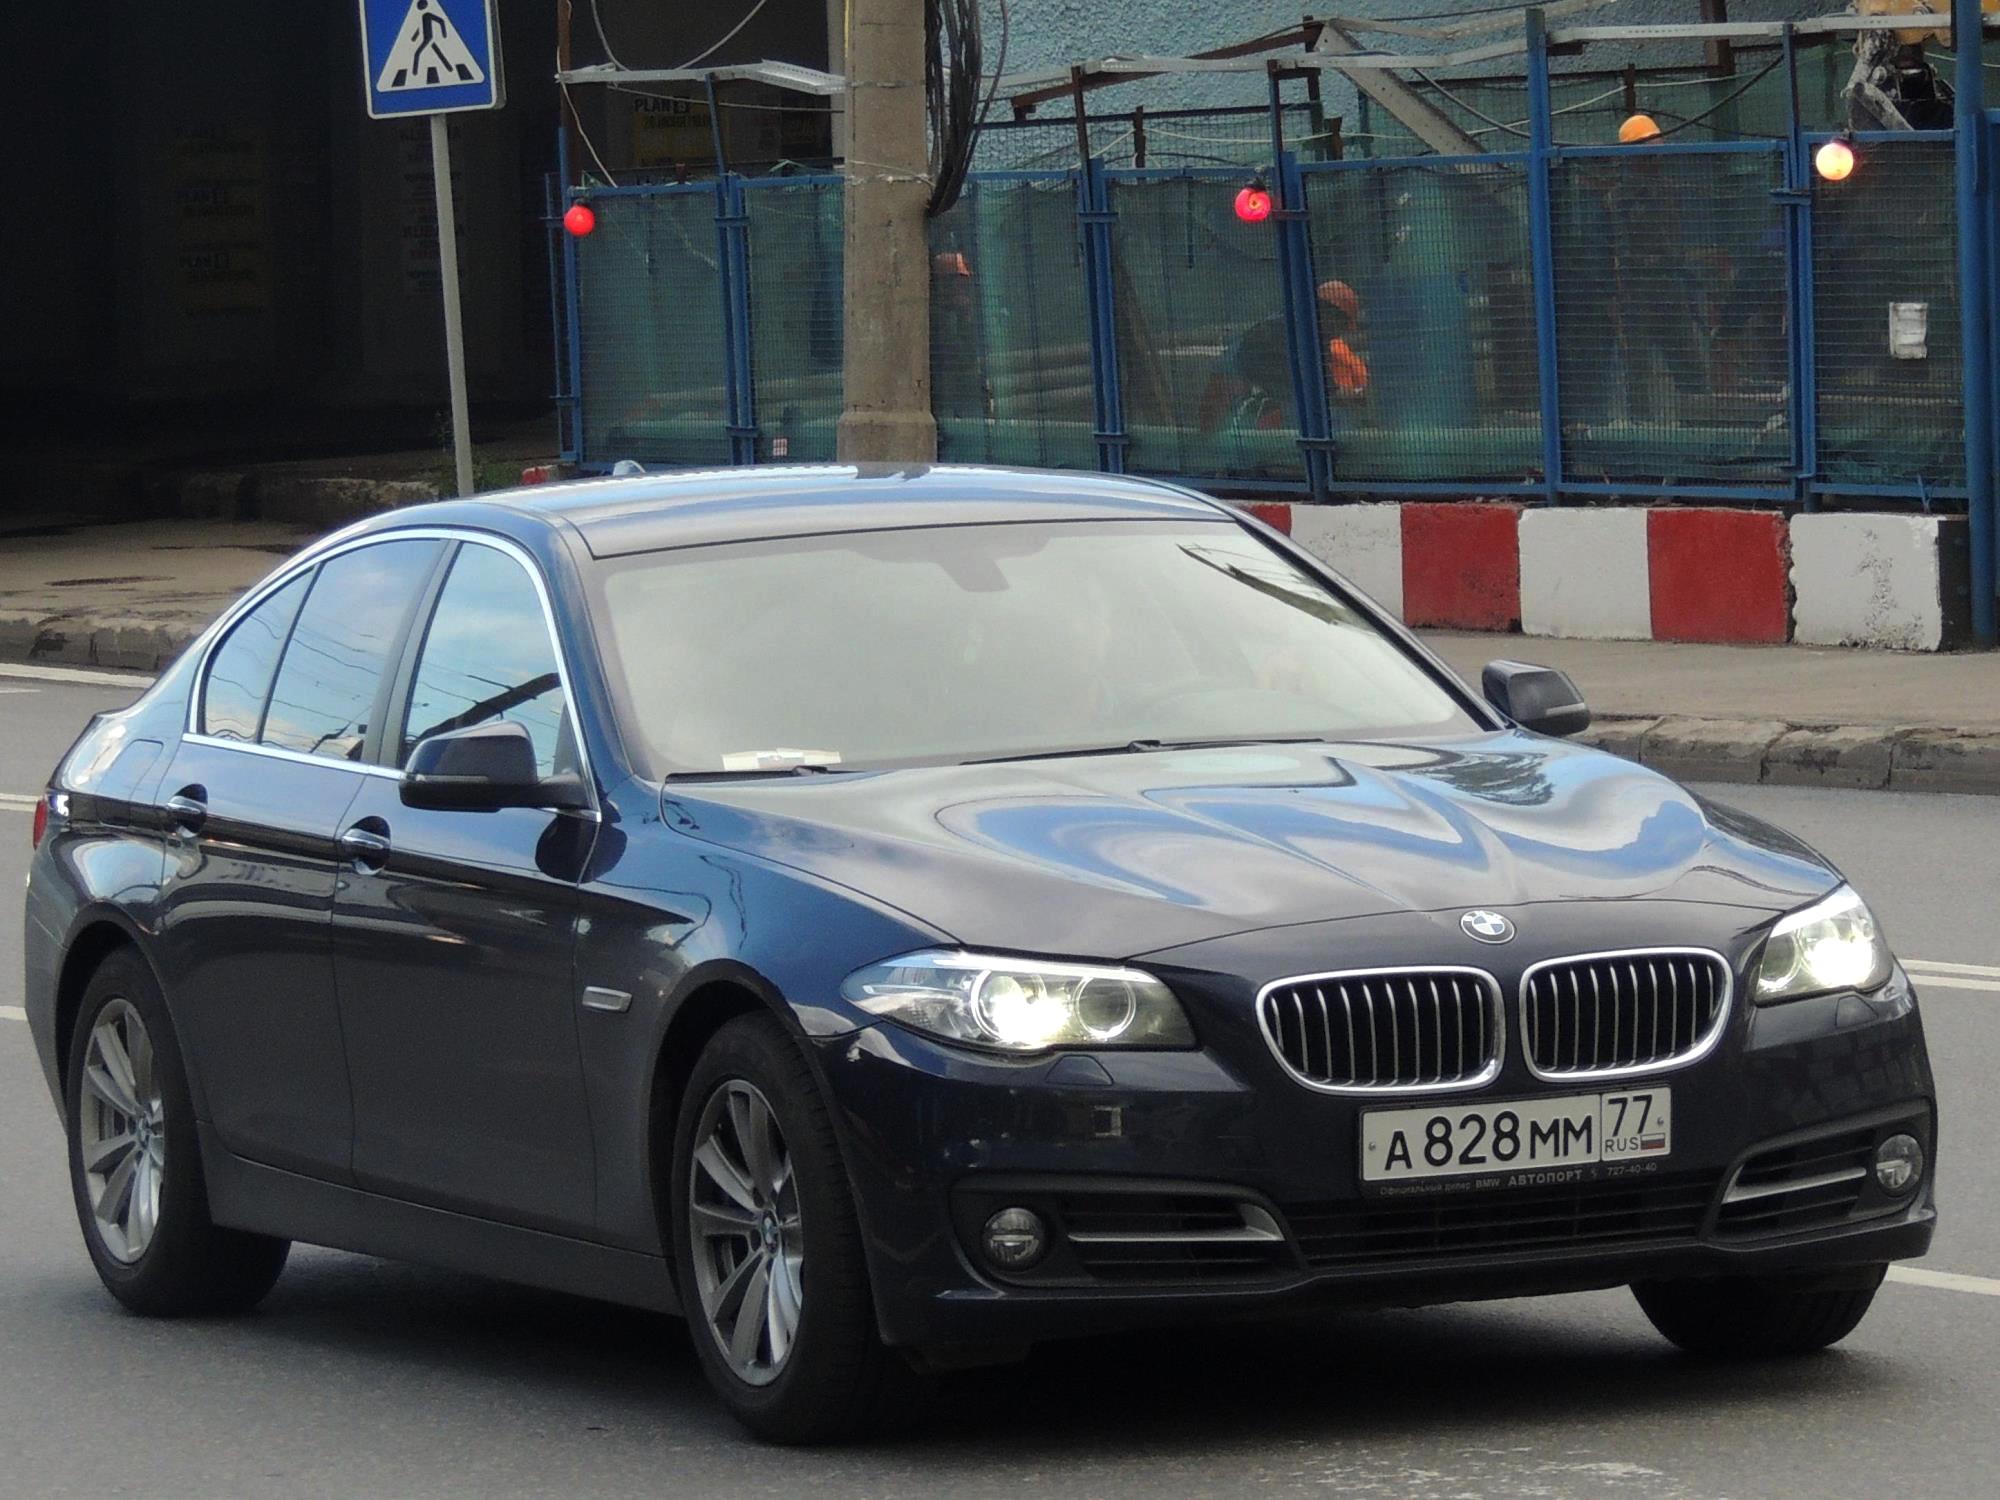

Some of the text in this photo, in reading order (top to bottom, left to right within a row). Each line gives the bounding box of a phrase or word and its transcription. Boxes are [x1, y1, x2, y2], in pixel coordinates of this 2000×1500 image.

[1606, 1094, 1653, 1137] 77
[1604, 1137, 1639, 1153] RUS
[1475, 1178, 1501, 1189] BMW
[1507, 1169, 1583, 1187] АВТОПОРТ
